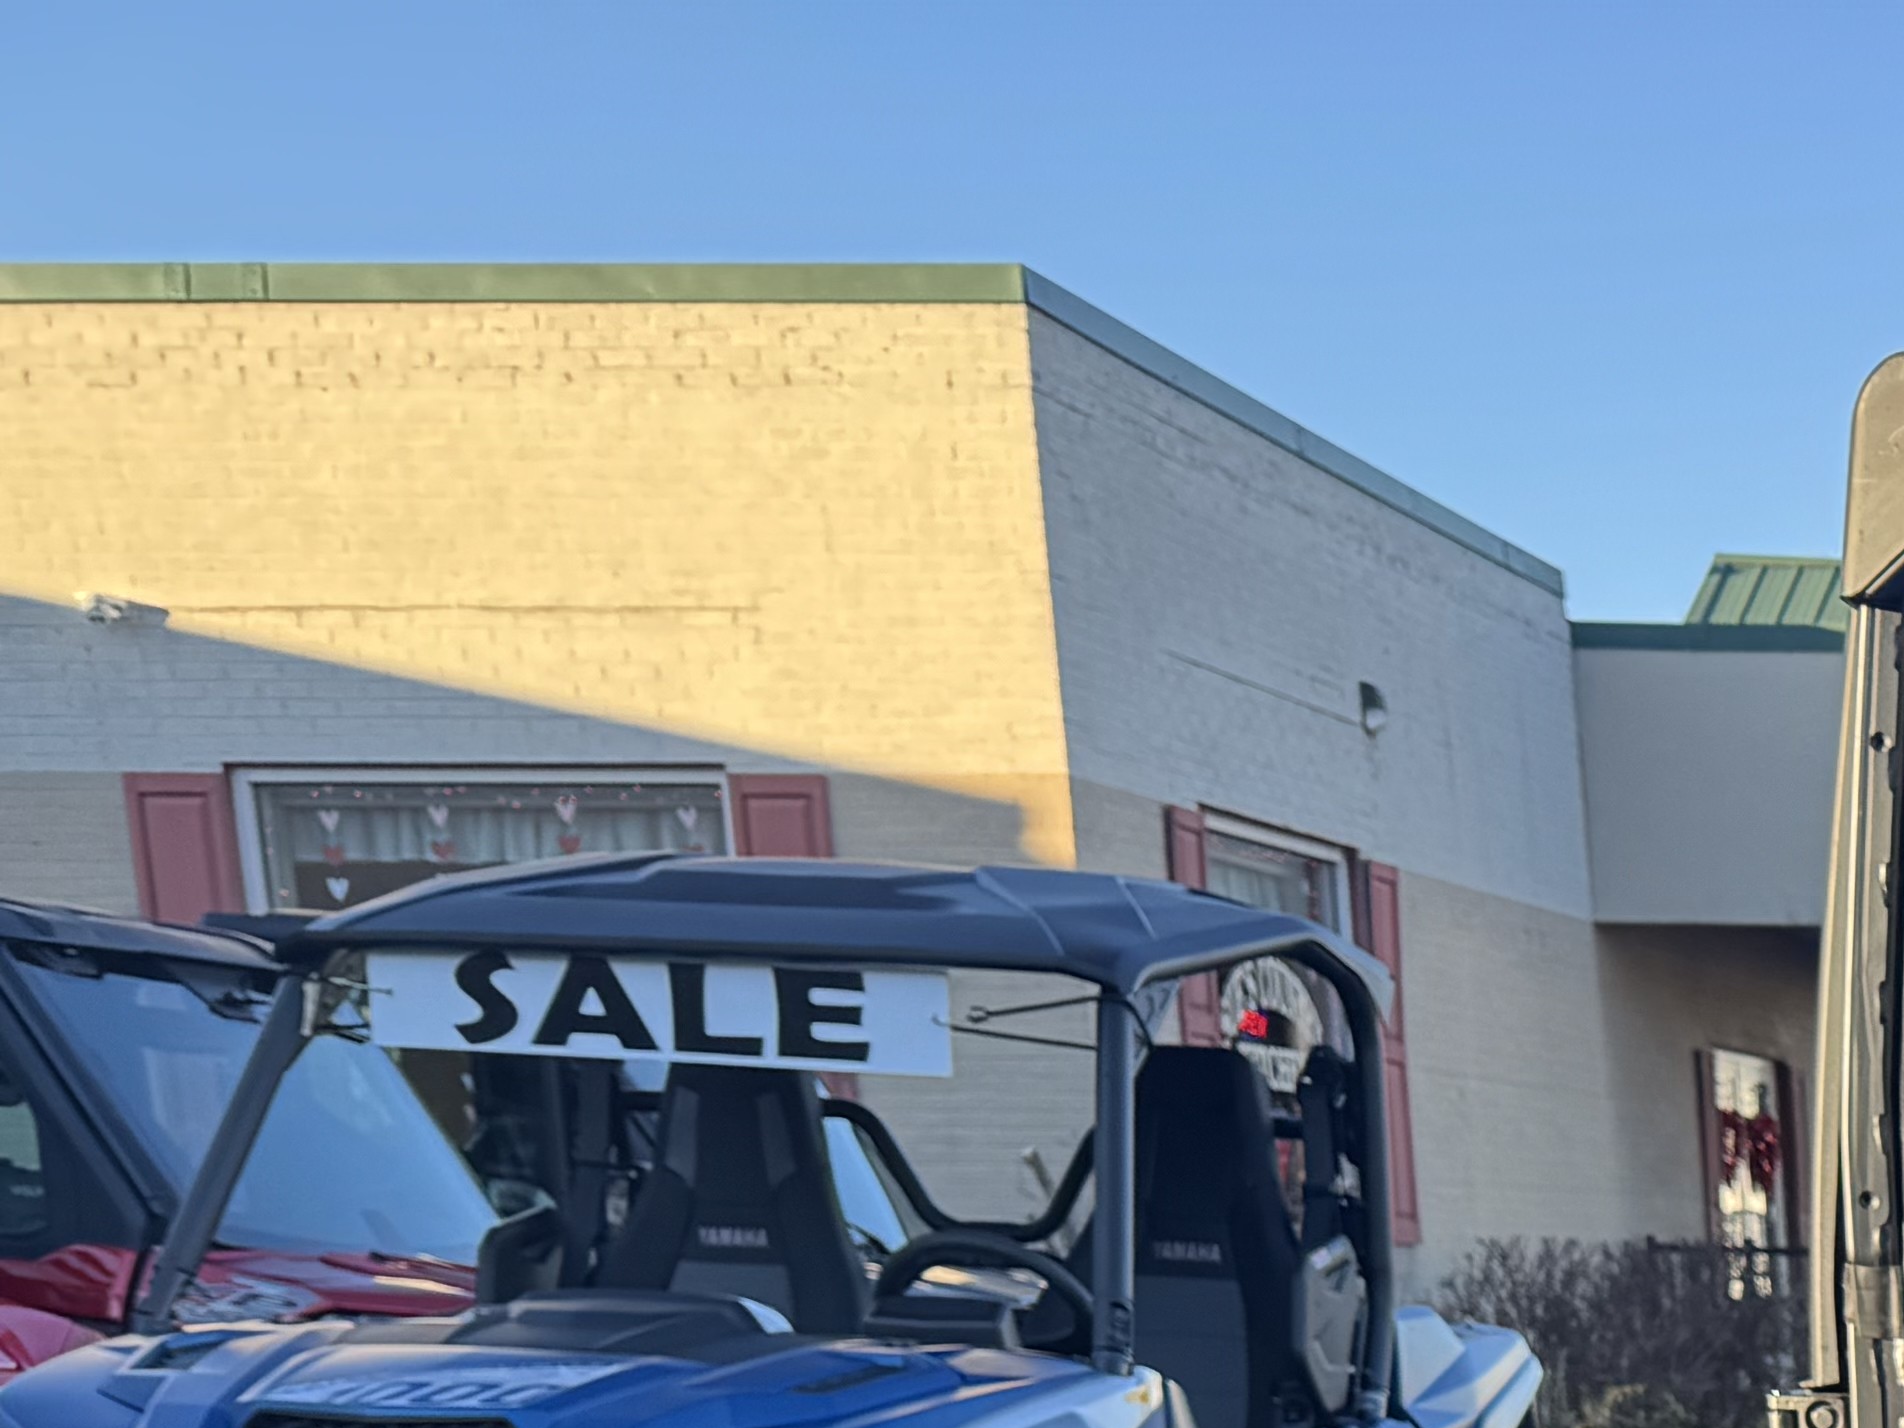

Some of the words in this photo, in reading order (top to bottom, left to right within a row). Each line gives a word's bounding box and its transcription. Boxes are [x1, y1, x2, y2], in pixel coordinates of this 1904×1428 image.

[454, 949, 870, 1062] SALE
[697, 1225, 769, 1247] YAMAHA
[1152, 1240, 1222, 1263] YAMAHA
